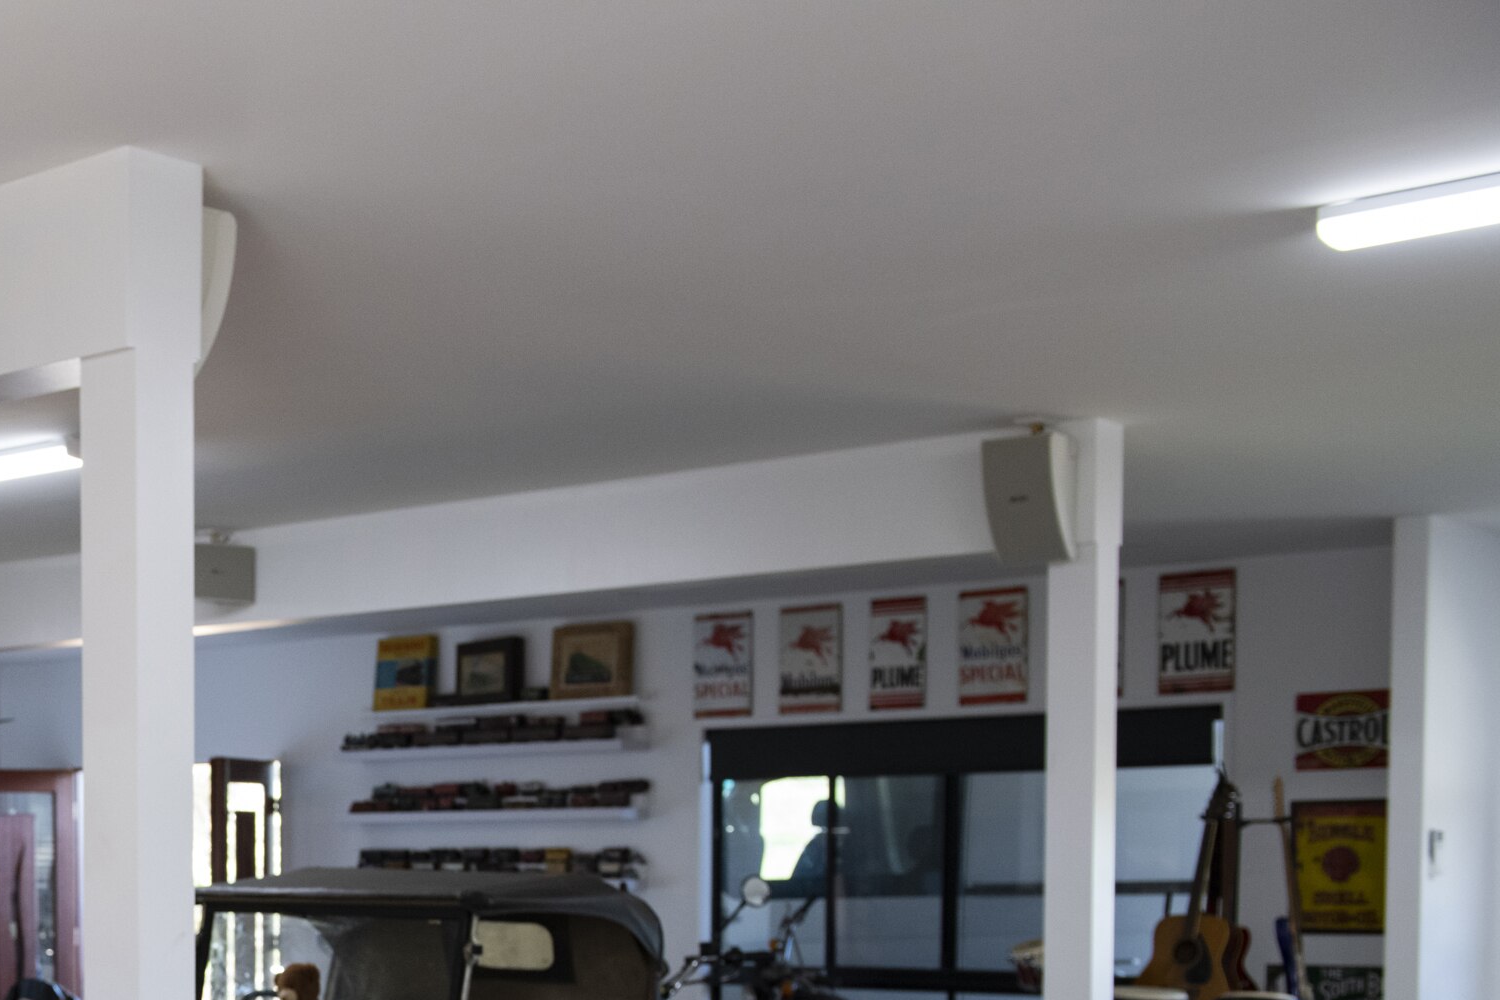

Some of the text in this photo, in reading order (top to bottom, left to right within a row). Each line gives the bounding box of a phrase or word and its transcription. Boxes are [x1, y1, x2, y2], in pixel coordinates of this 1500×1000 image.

[1161, 639, 1233, 672] PLUME
[871, 665, 921, 689] PLUME
[960, 663, 1025, 685] SPECIAL
